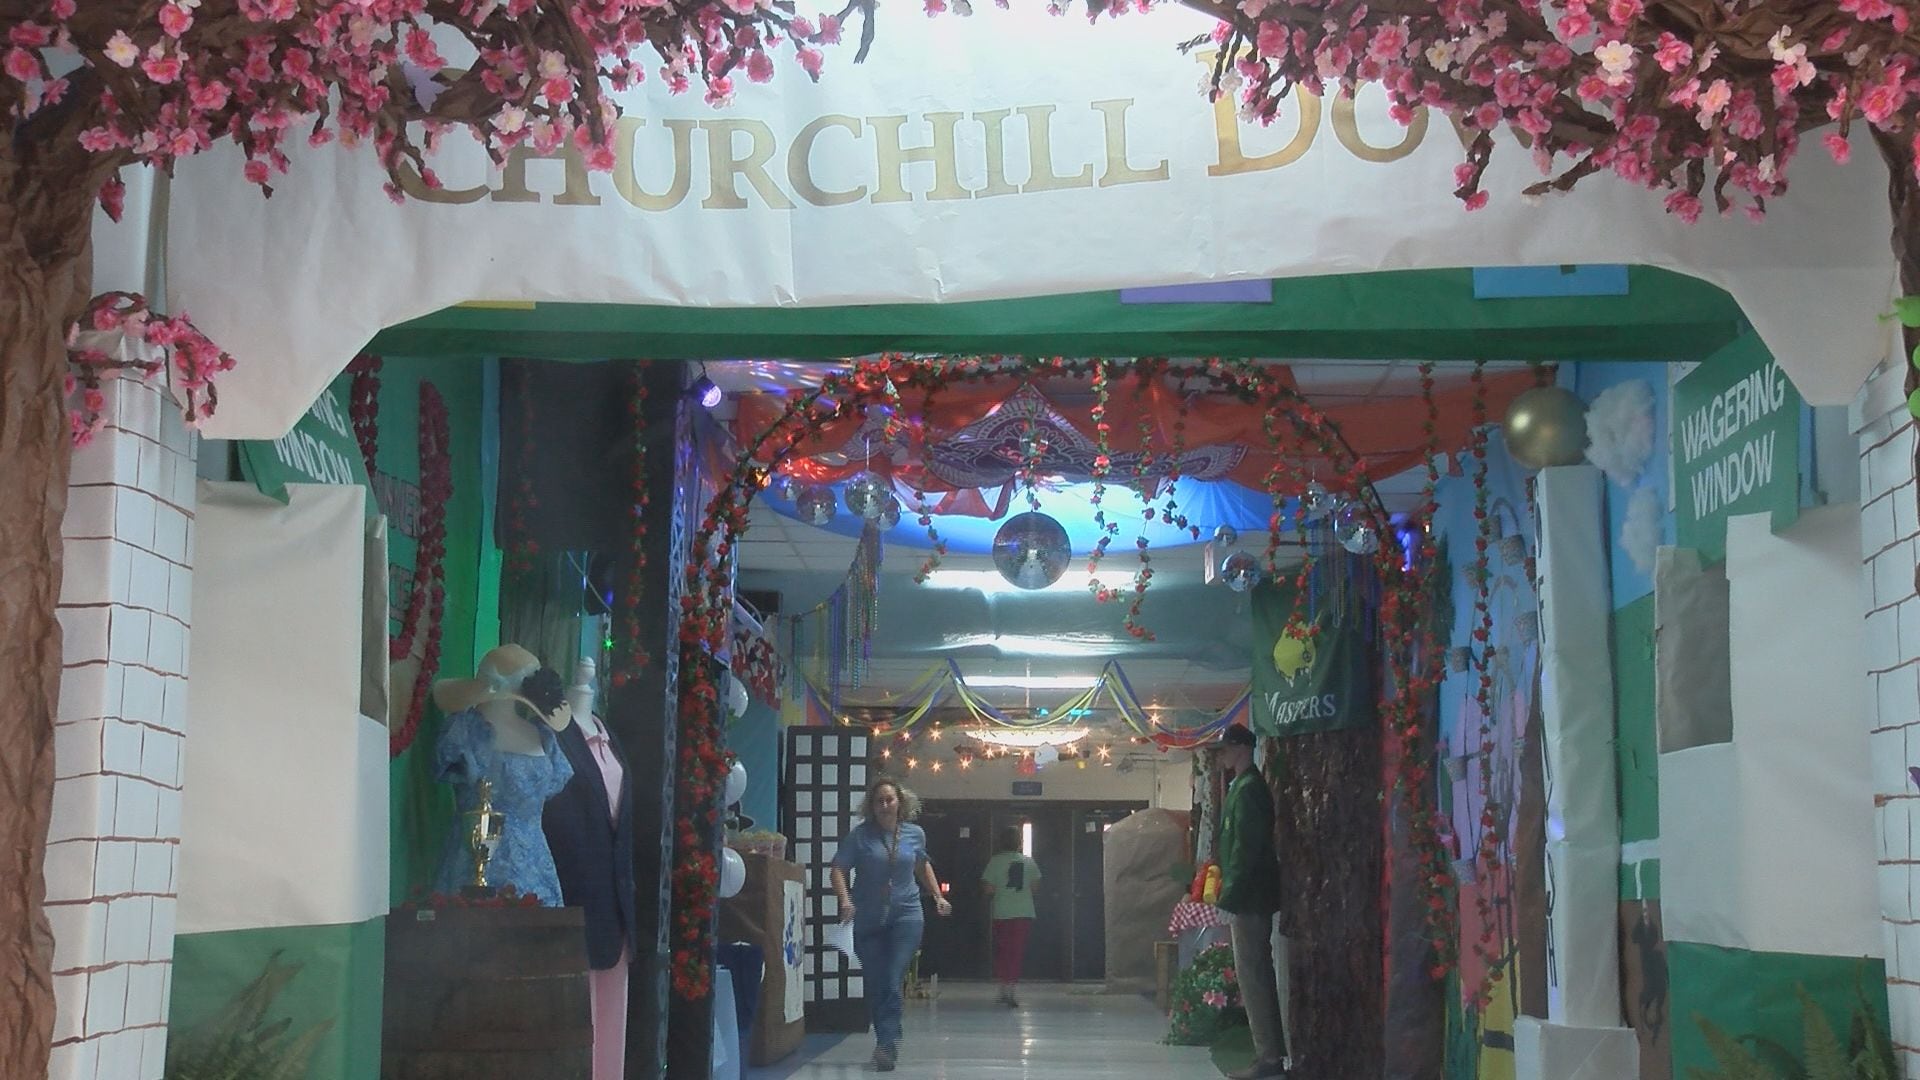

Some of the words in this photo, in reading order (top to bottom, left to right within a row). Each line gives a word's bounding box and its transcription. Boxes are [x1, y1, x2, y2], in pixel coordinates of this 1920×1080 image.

[375, 68, 1169, 210] CHURCHILL
[1681, 361, 1785, 464] WAGERING
[1691, 430, 1775, 521] WINDOW
